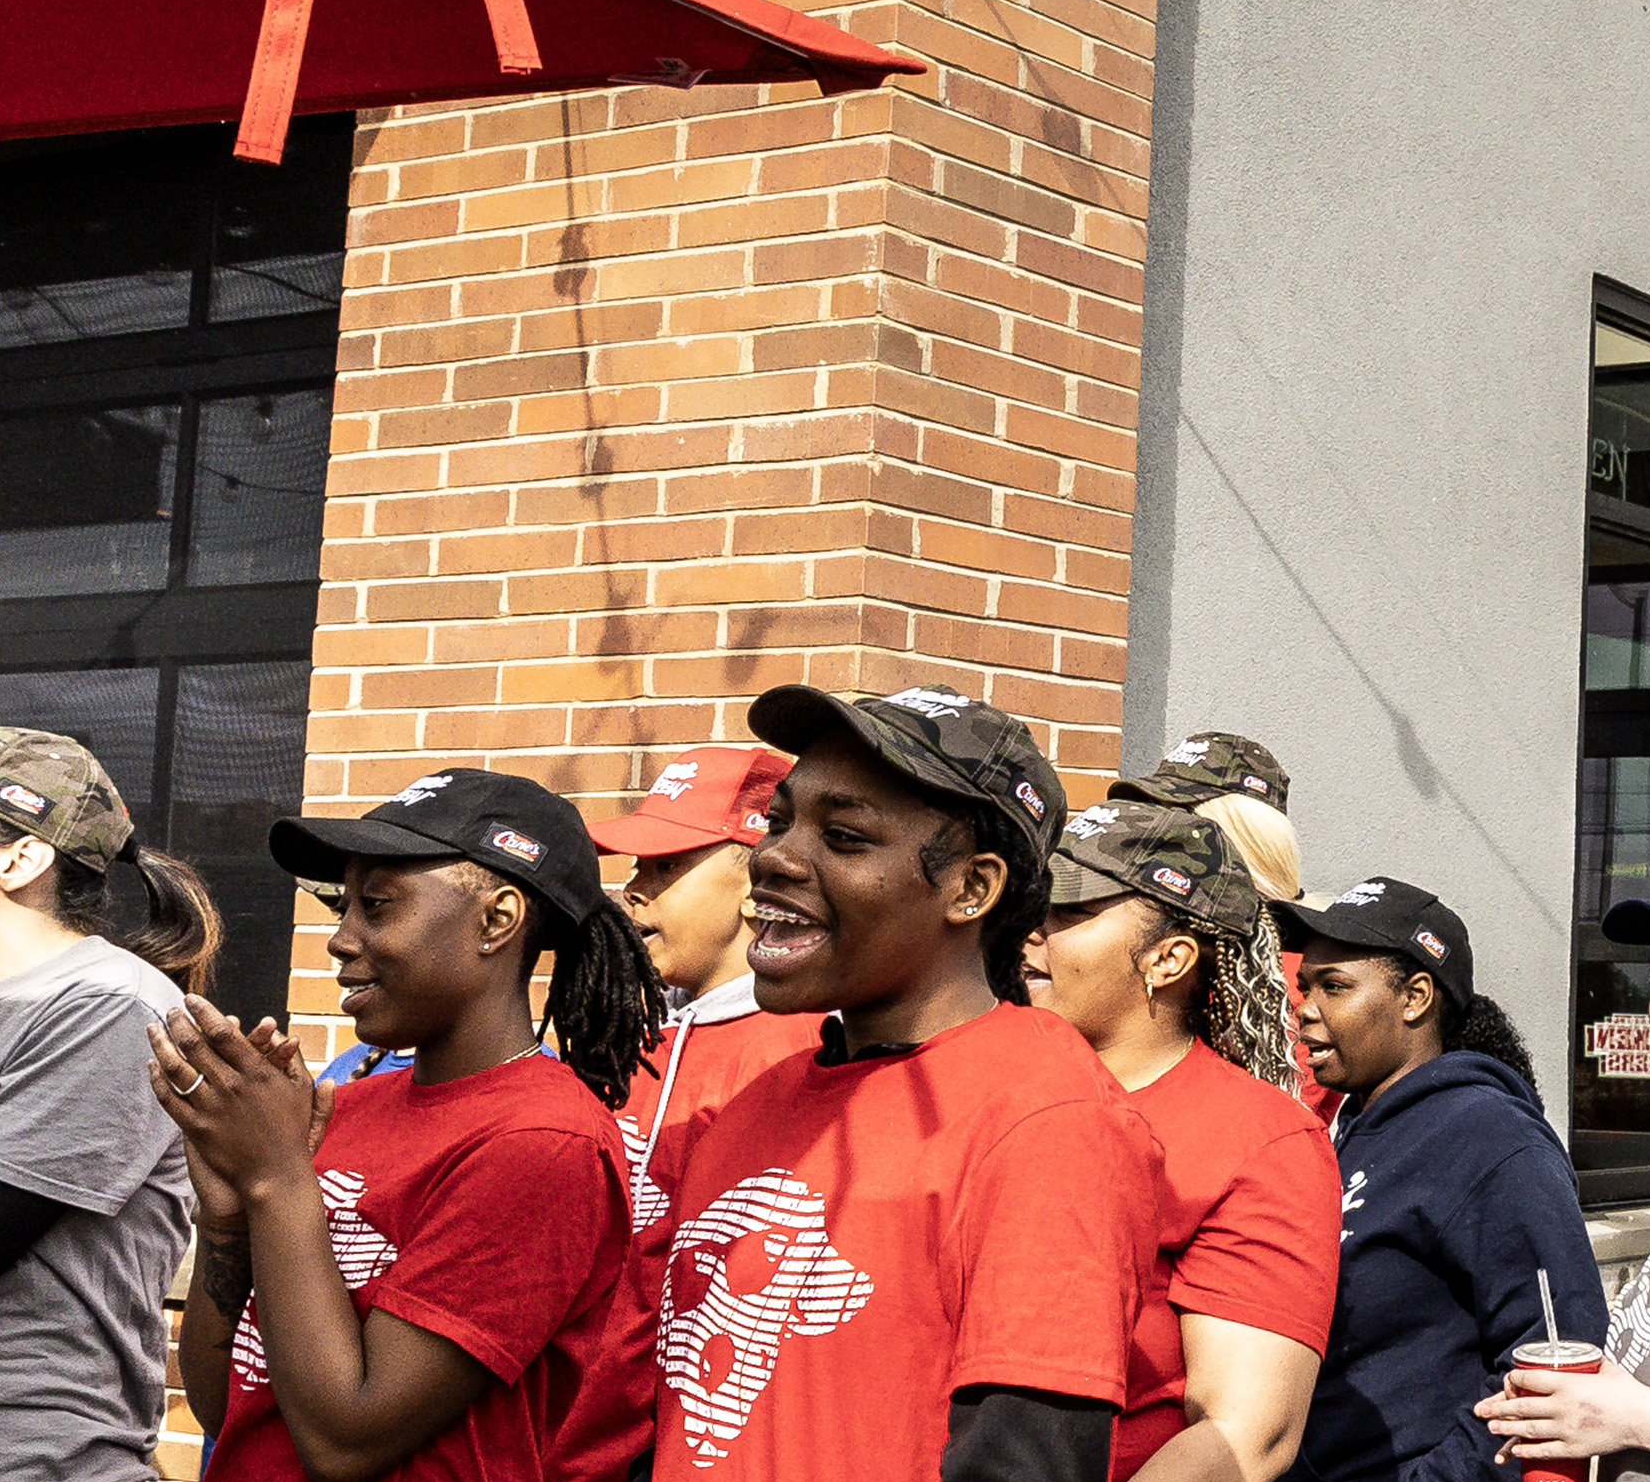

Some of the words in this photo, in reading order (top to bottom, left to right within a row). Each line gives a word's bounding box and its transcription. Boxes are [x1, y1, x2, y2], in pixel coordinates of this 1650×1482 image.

[1015, 781, 1045, 814] Cane's
[492, 830, 536, 855] Cane's
[1153, 867, 1191, 890] Cane's
[1416, 932, 1445, 955] Cane's
